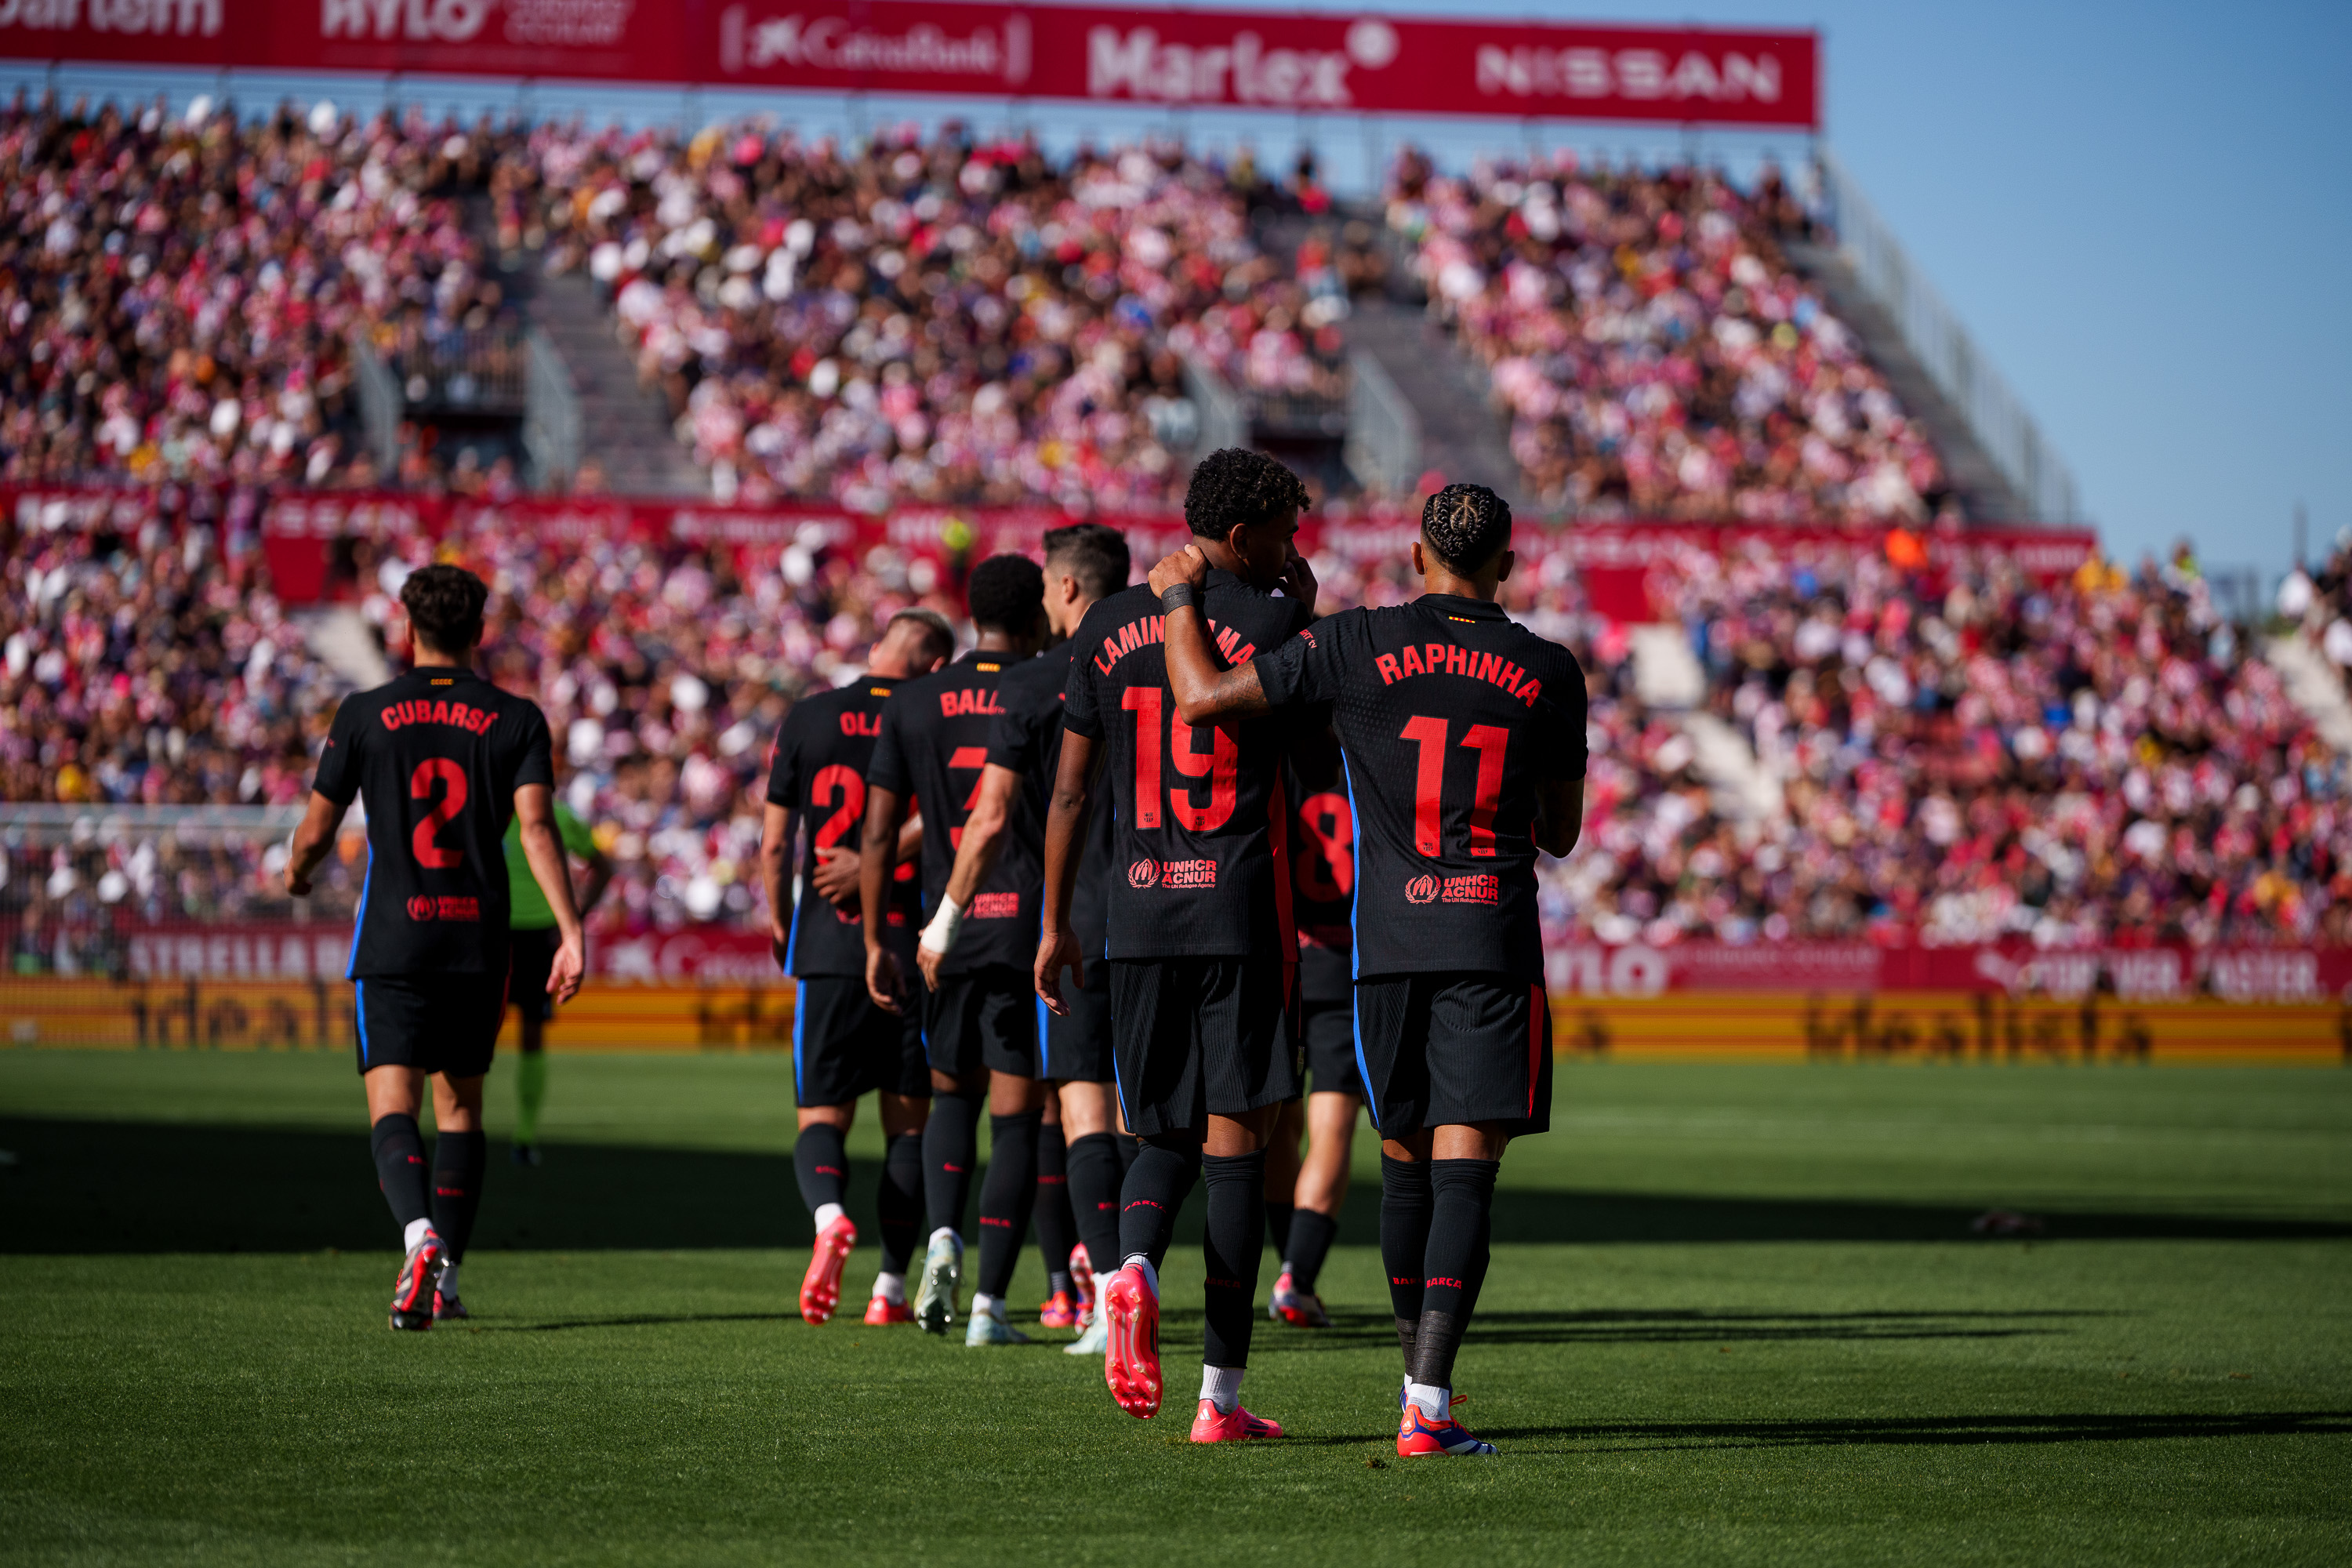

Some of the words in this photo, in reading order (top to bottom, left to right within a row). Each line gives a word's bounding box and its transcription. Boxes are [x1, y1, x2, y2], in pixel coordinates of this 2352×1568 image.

[1087, 25, 1353, 105] Marlex
[1475, 44, 1783, 103] NISSAN
[1094, 615, 1165, 677] LAMIN
[1374, 643, 1542, 707] RAPHINHA
[1121, 686, 1239, 833] 19
[1399, 715, 1509, 857] 11
[411, 757, 467, 869] 2
[1161, 871, 1216, 884] ACNUR
[1163, 859, 1217, 873] UNHCR
[1296, 792, 1354, 902] 8
[1441, 886, 1498, 900] ACNUR
[1444, 874, 1499, 887] UNHCR
